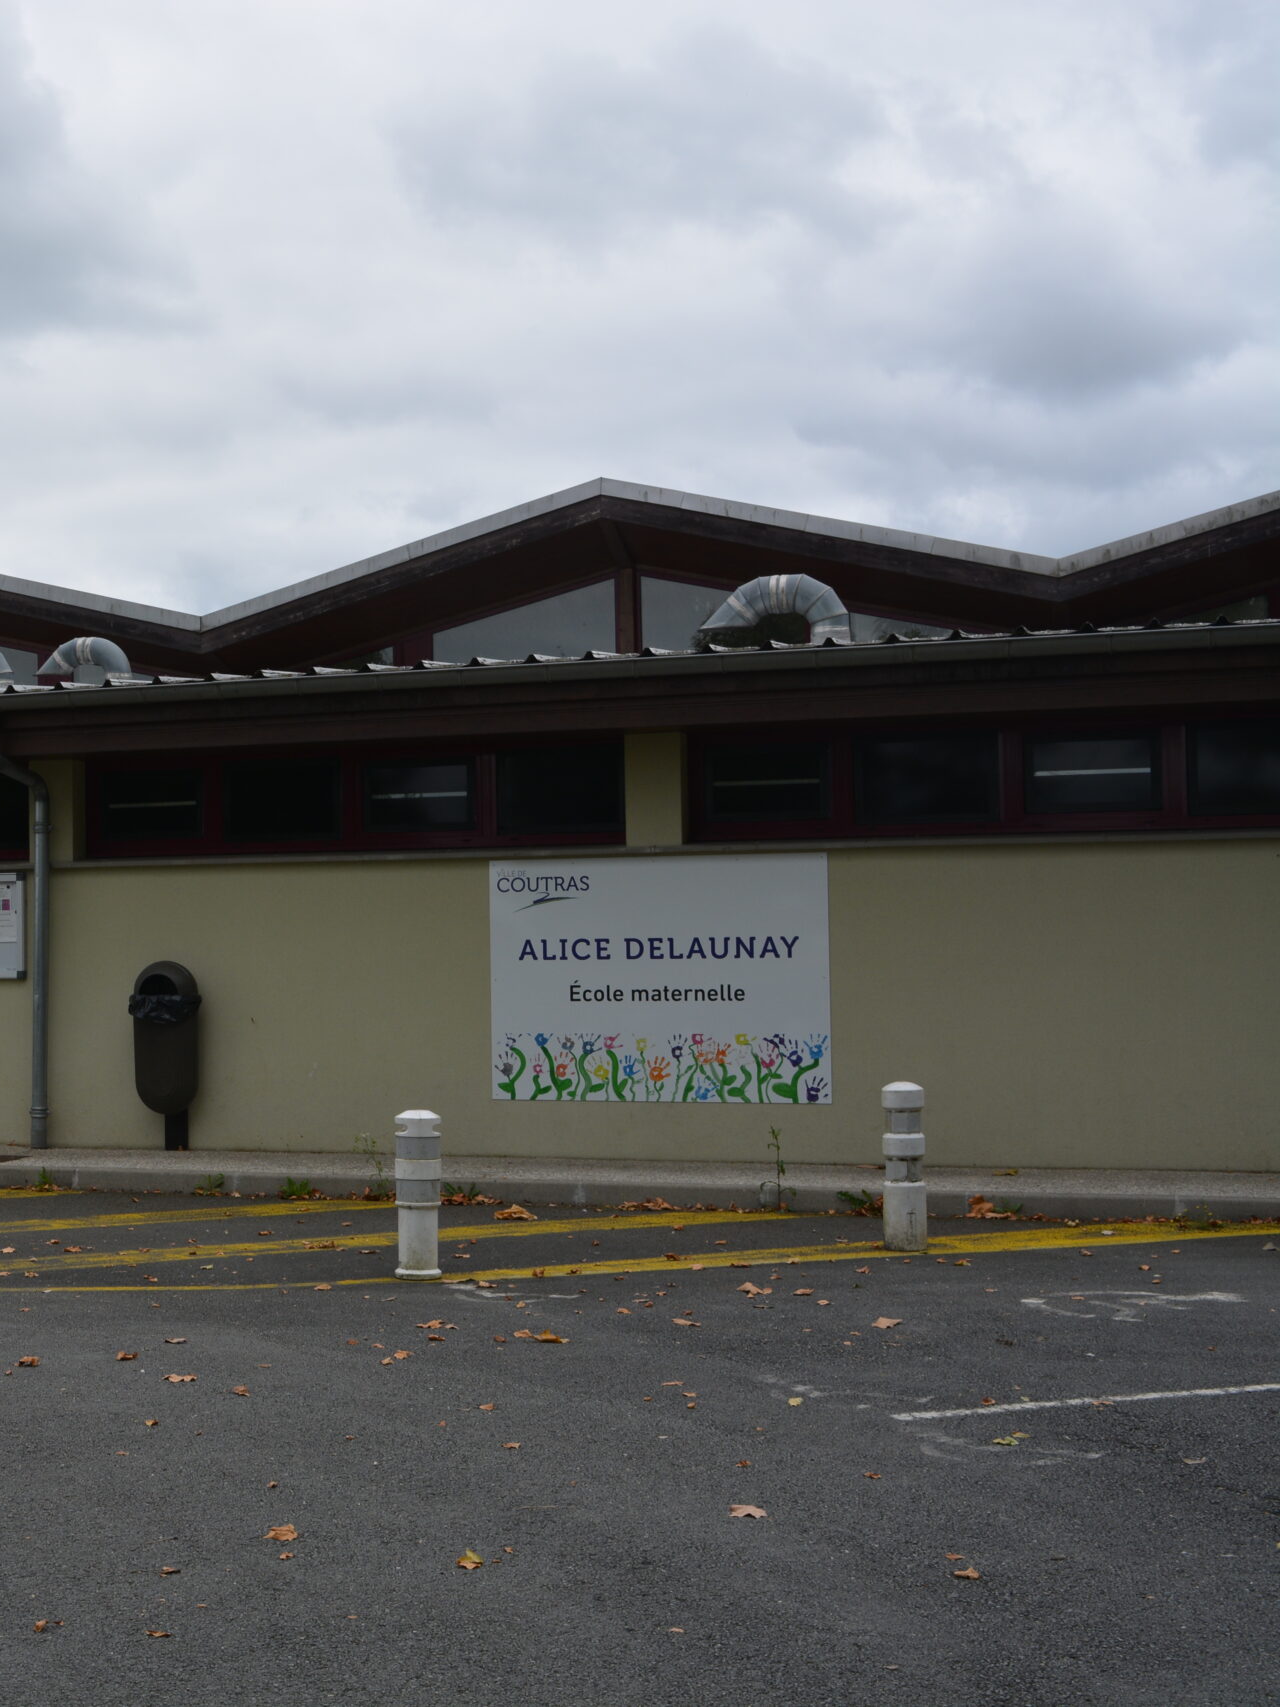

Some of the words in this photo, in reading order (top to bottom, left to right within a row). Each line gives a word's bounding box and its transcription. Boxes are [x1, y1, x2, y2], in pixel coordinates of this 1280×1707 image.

[497, 869, 516, 877] VILLE
[497, 875, 590, 893] COUTRAS
[519, 937, 612, 961] ALICE
[624, 936, 800, 960] DELAUNAY
[570, 980, 624, 1002] École
[632, 984, 746, 1002] maternelle
